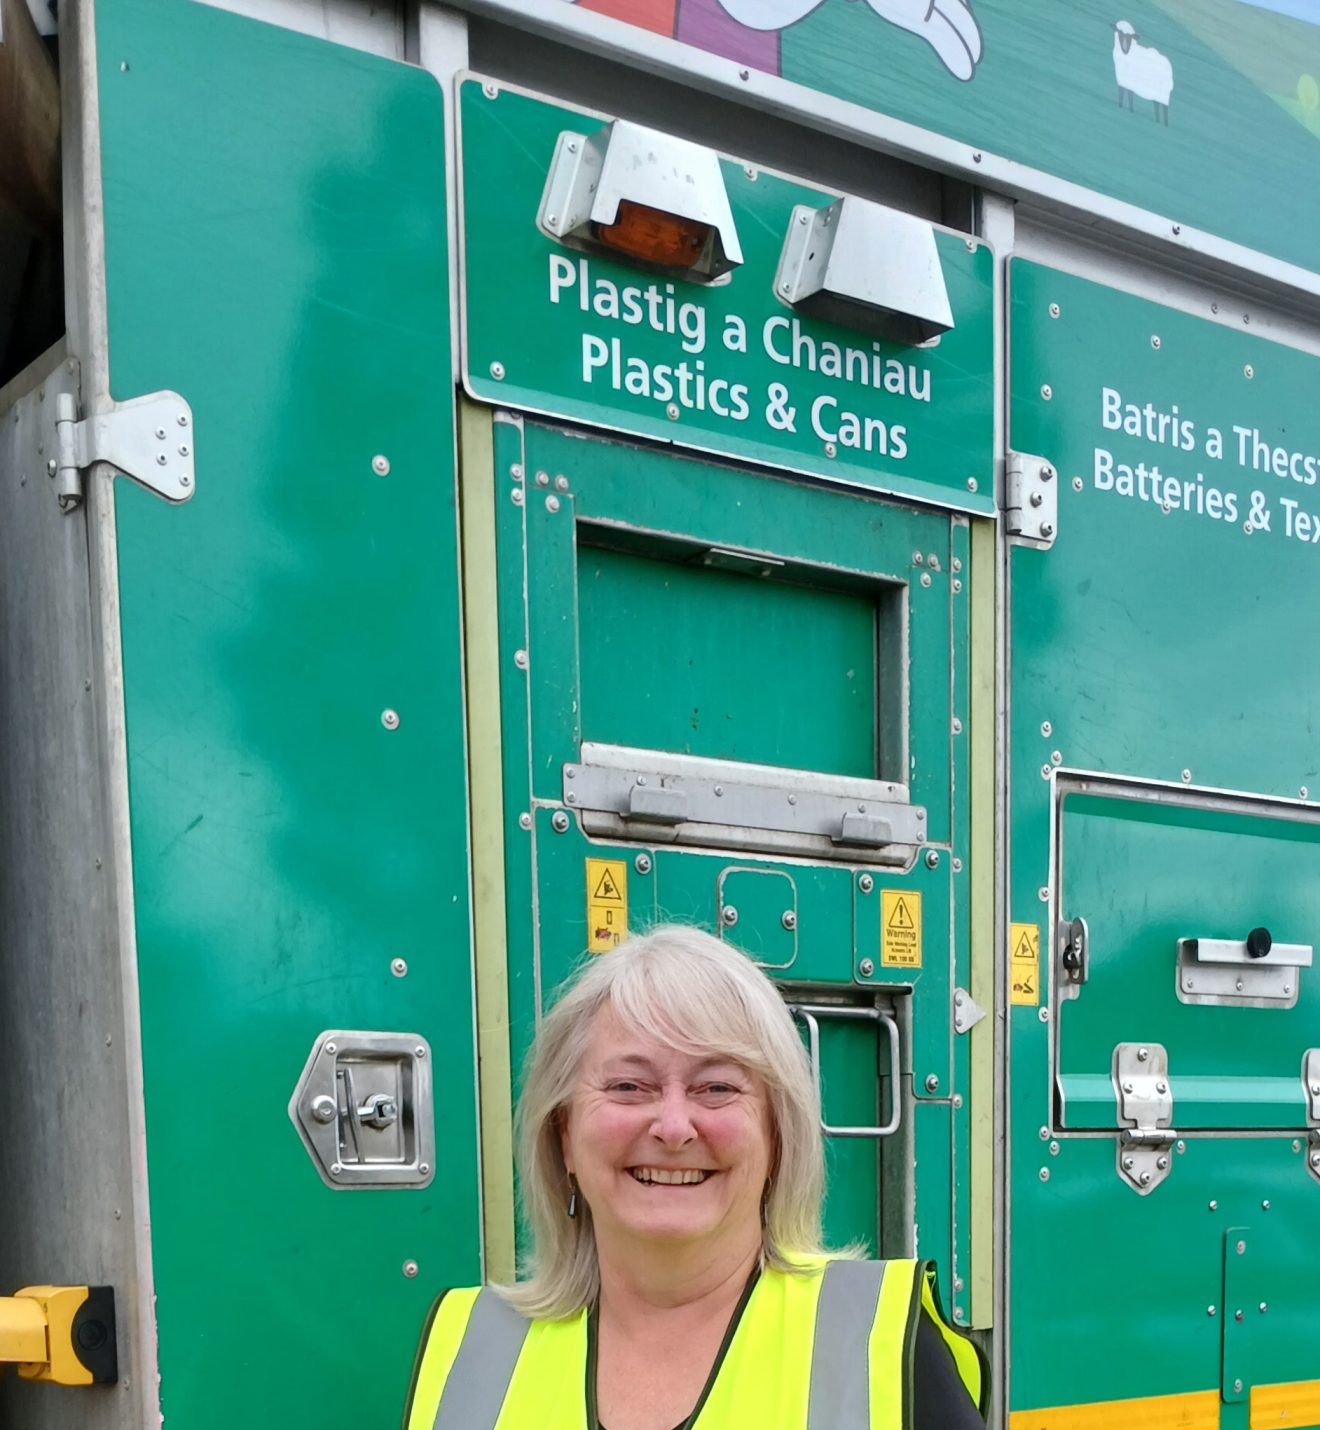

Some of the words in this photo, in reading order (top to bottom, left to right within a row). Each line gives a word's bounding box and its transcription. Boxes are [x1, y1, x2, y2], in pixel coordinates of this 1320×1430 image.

[549, 253, 705, 353] Plastig
[722, 315, 747, 353] a
[763, 315, 932, 402] Chaniau
[582, 334, 749, 420] Plastics
[765, 382, 796, 433] &
[811, 395, 908, 460] Cans
[1102, 387, 1195, 451] Batris
[1206, 427, 1223, 459] a
[1233, 425, 1320, 486] Thecs
[1094, 447, 1238, 522] Batteries
[1250, 490, 1271, 532] &
[886, 929, 916, 940] Warning
